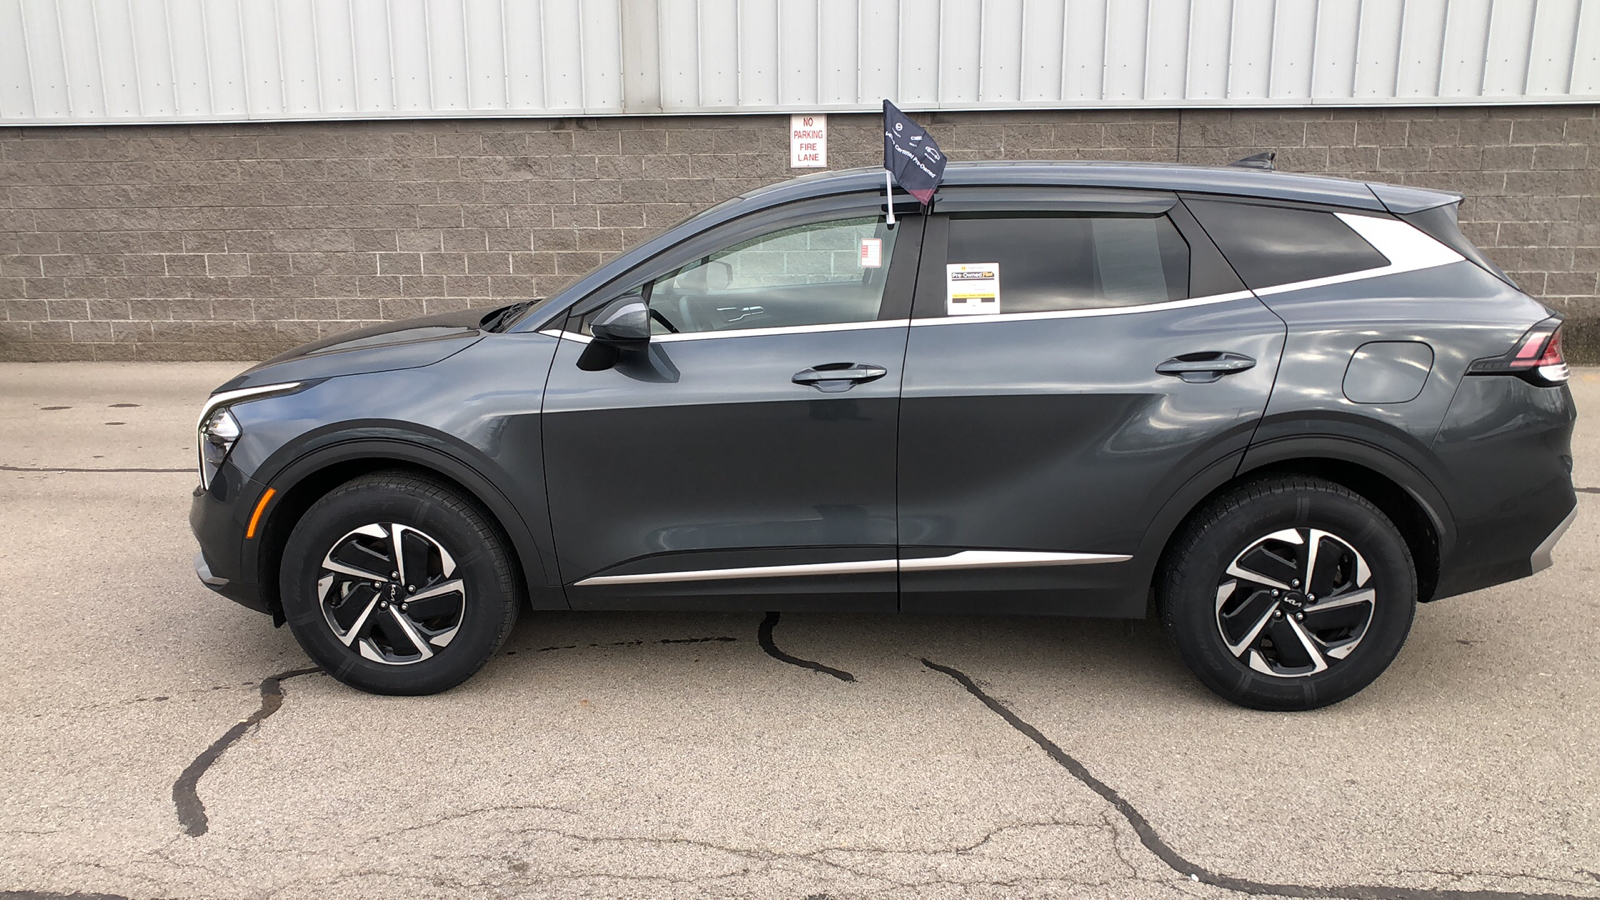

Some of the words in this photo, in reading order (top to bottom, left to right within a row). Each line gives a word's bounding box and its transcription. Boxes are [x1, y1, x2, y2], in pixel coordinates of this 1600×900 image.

[803, 117, 814, 127] NO
[793, 130, 823, 139] PARKING
[797, 153, 820, 161] LANE
